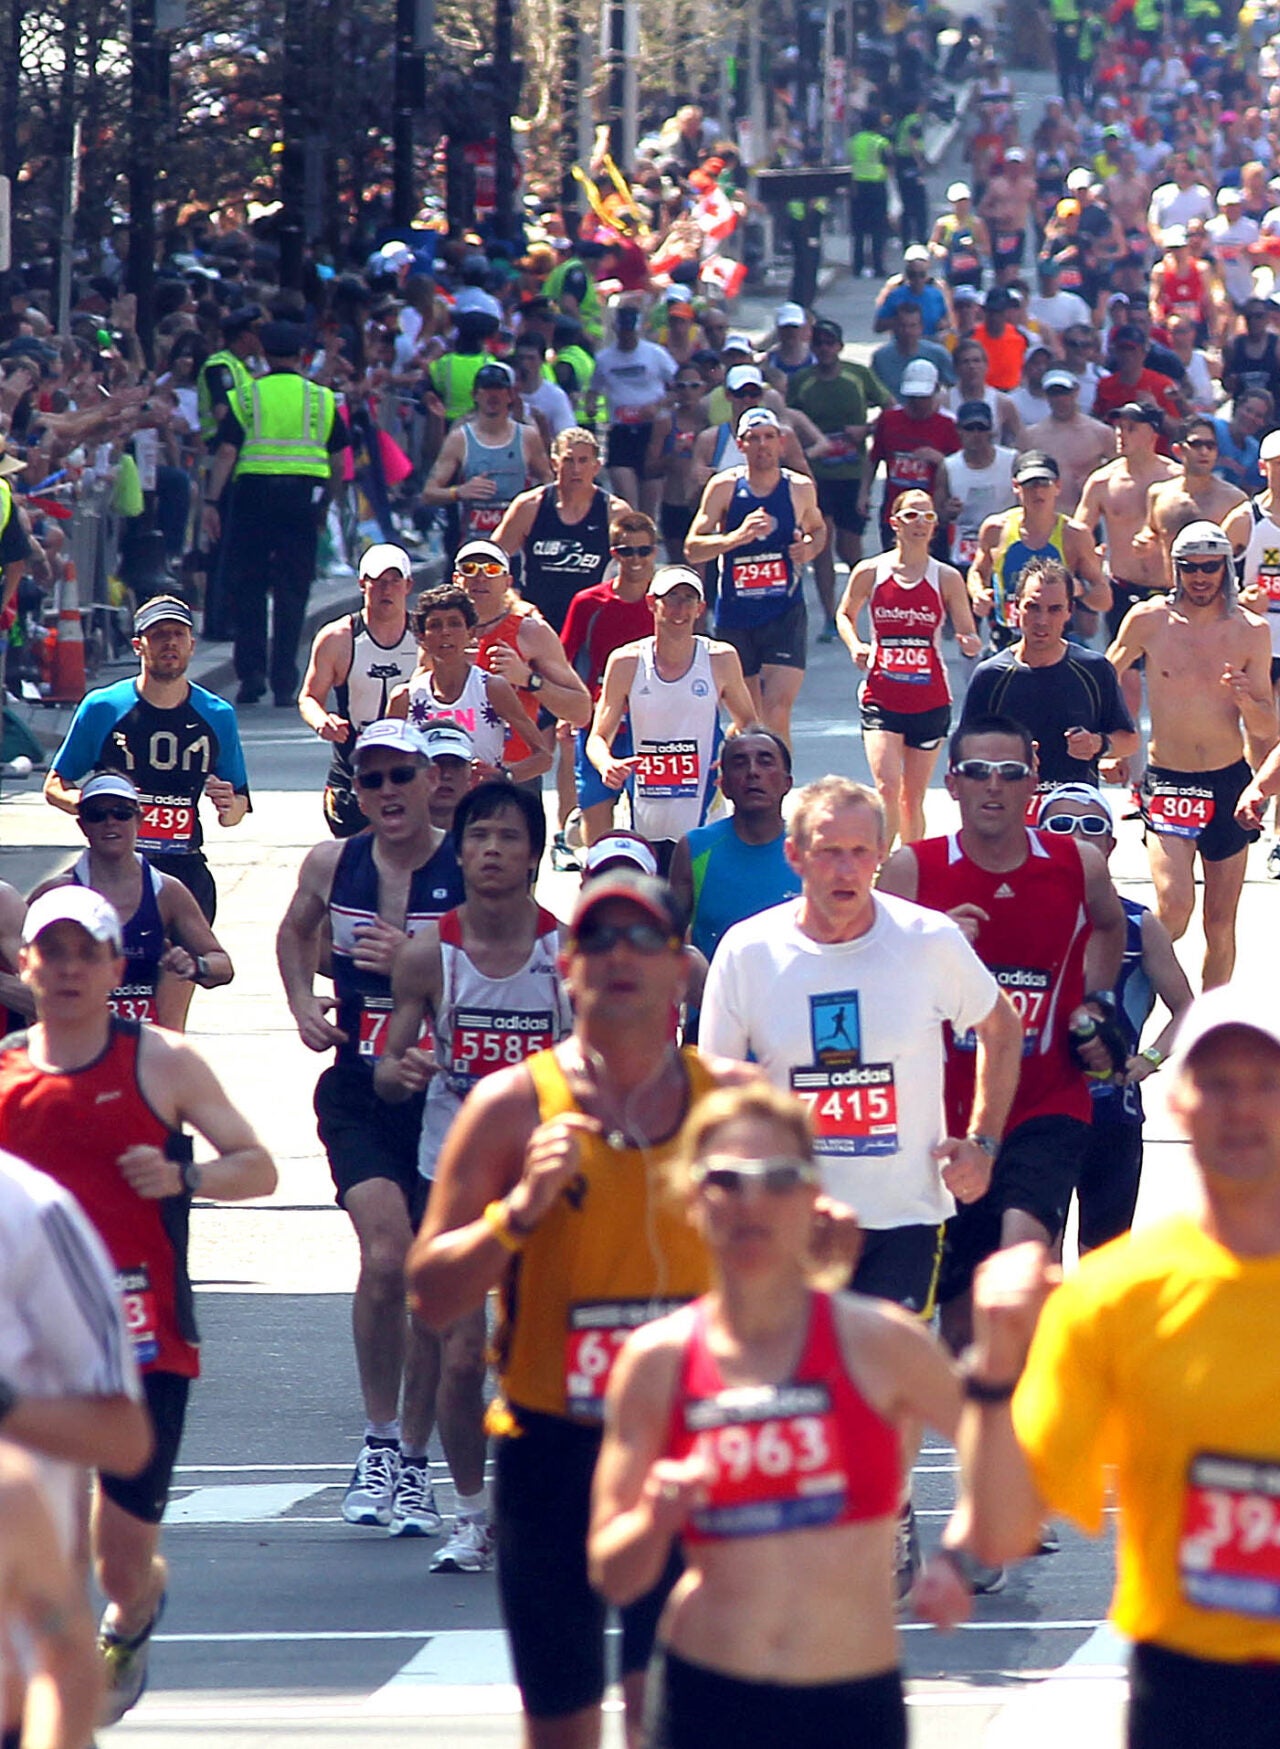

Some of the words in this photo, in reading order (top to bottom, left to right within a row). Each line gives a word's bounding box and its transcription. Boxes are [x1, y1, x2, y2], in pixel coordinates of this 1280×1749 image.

[736, 565, 781, 581] 2941
[658, 743, 696, 754] adidas
[637, 755, 694, 775] 4515
[154, 795, 192, 806] adidas
[1178, 787, 1214, 800] adidas
[1162, 797, 1207, 819] 804
[141, 807, 190, 830] 439
[999, 969, 1048, 987] adidas
[113, 983, 153, 996] adidas
[493, 1014, 549, 1031] adidas
[461, 1032, 545, 1063] 5585
[830, 1068, 891, 1086] adidas
[798, 1087, 889, 1122] 7415
